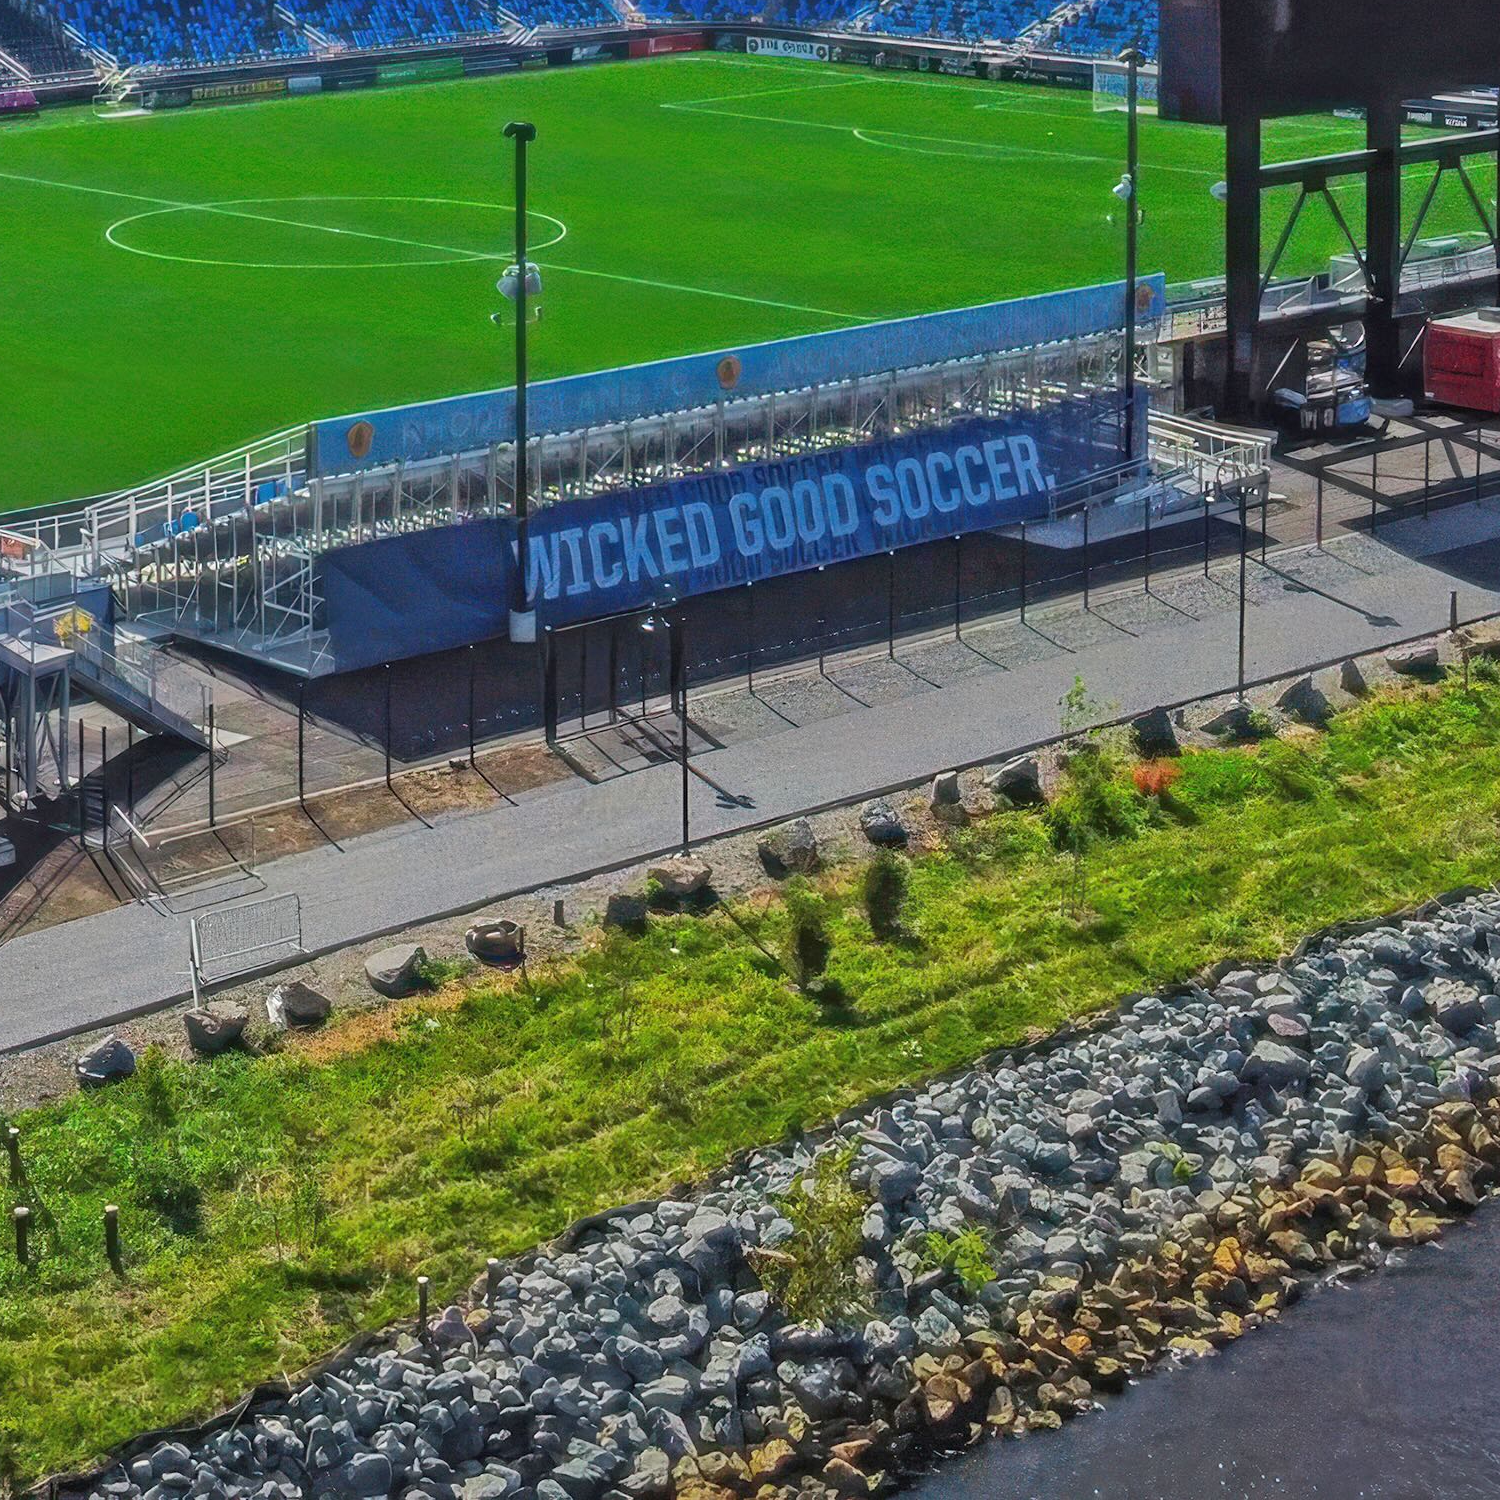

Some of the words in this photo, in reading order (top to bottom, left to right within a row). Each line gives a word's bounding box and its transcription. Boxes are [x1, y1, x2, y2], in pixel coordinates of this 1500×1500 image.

[511, 500, 720, 601] WICKED
[730, 473, 860, 558] GOOD
[866, 434, 1057, 528] SOCCER.
